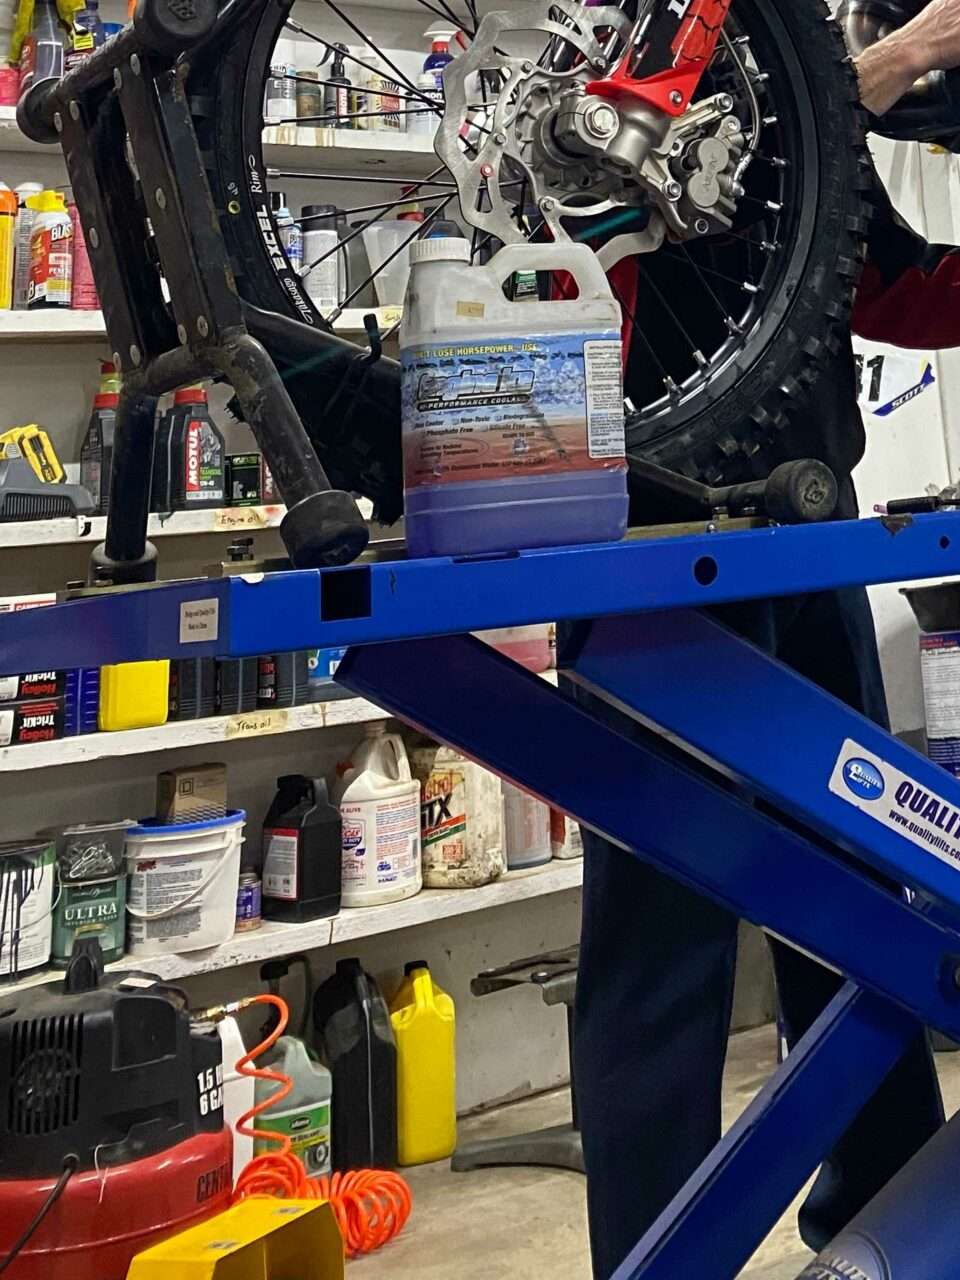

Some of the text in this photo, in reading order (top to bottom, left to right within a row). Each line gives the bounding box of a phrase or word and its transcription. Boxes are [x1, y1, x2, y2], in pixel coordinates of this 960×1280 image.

[256, 204, 288, 271] EXCEL
[189, 428, 198, 485] MOTUL
[422, 776, 452, 801] strol
[65, 901, 117, 921] ULTRA
[197, 1068, 213, 1094] 1.5
[199, 1088, 224, 1116] 6 GA
